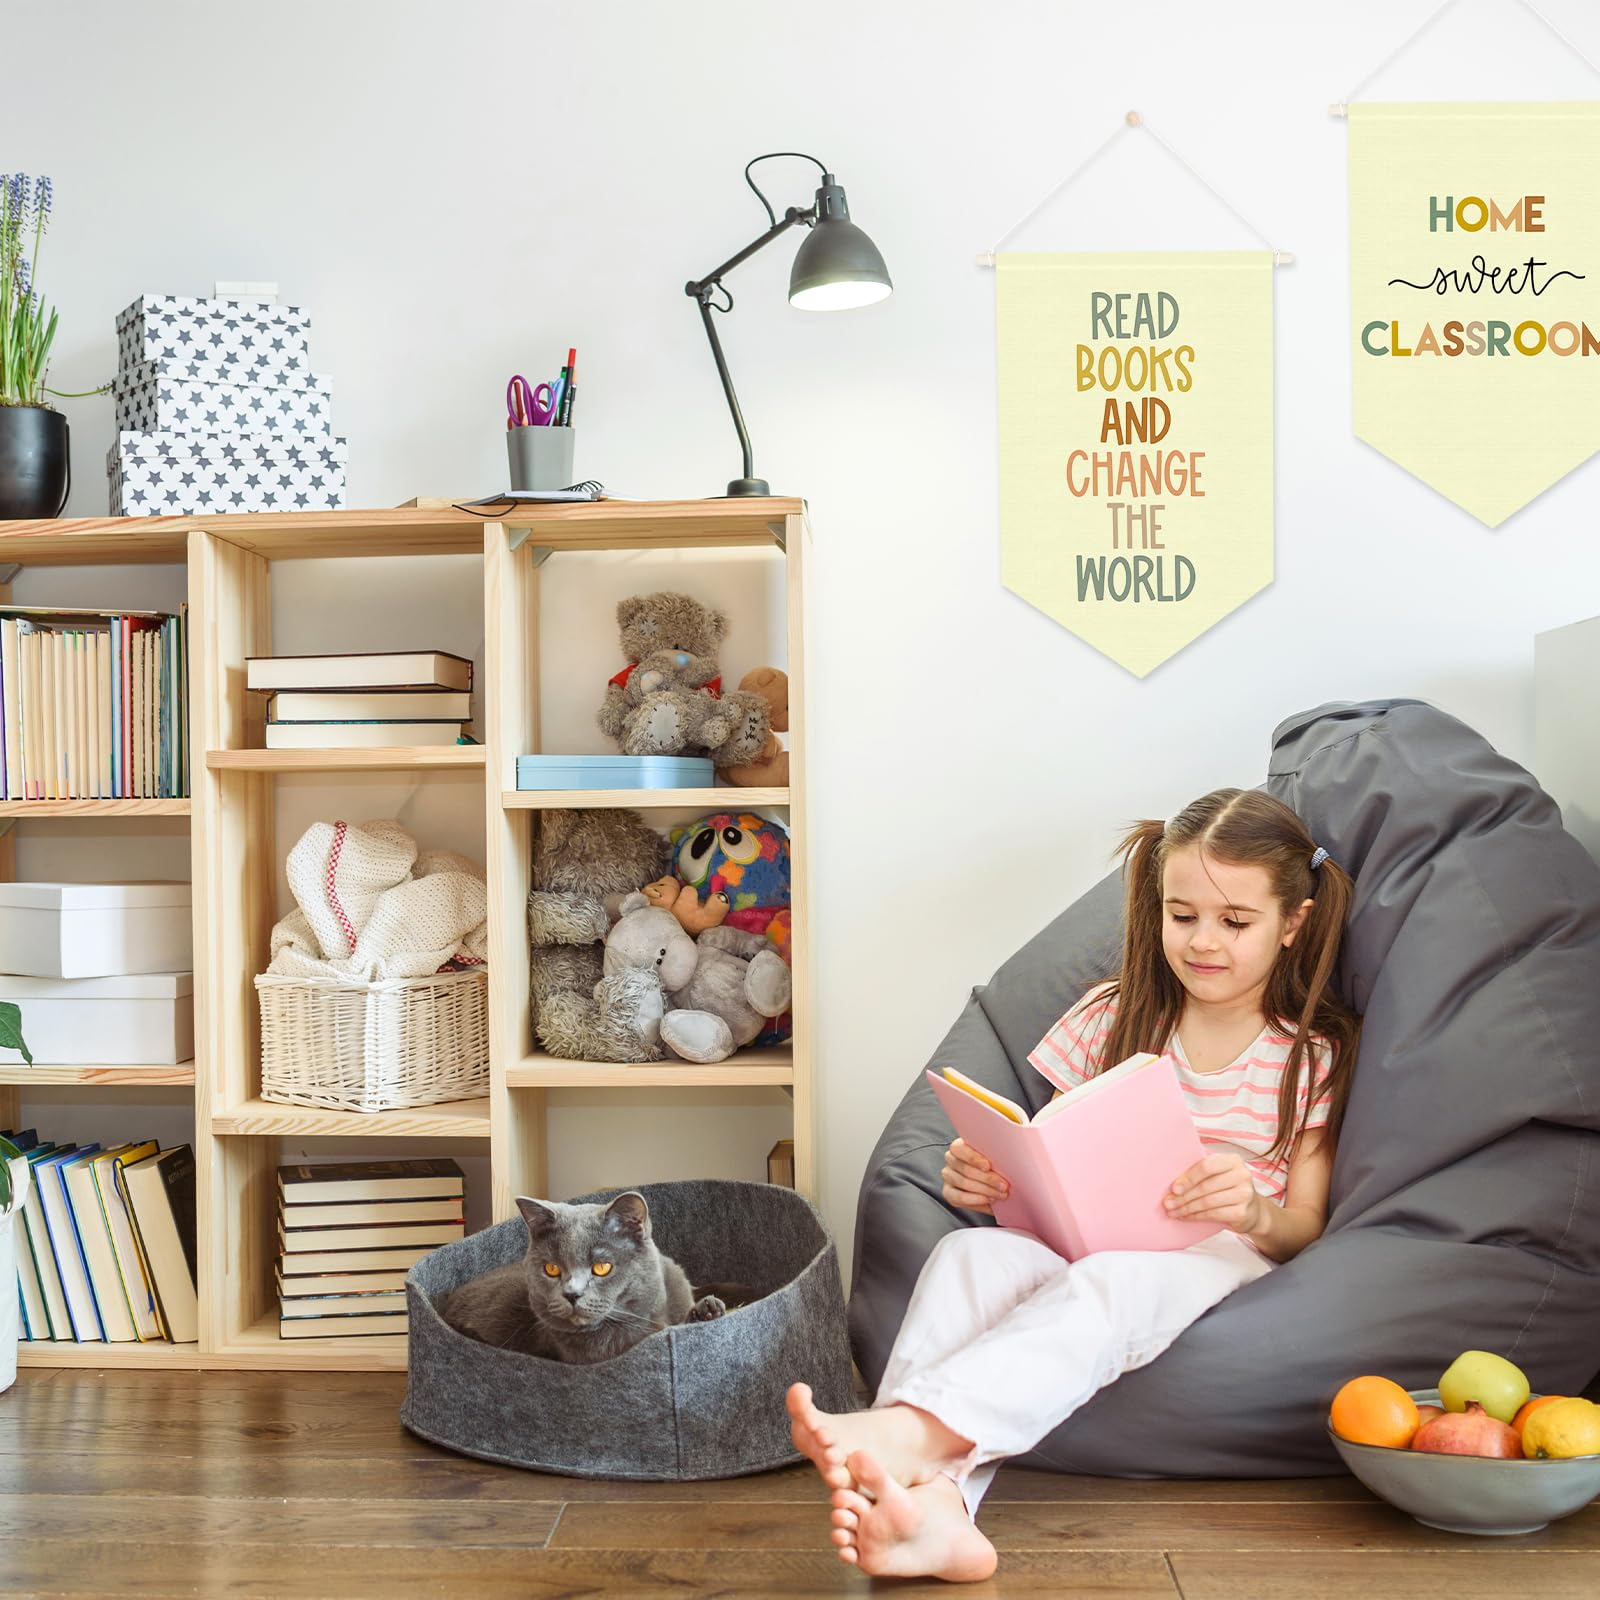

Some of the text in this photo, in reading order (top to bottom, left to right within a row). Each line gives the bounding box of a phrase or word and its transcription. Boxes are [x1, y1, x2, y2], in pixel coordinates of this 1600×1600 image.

[1429, 195, 1546, 233] HOME
[1388, 255, 1586, 296] sweet
[1091, 291, 1179, 340] READ
[1075, 344, 1195, 393] BOOKS
[1100, 396, 1172, 446] AND
[1066, 449, 1206, 498] CHANGE
[1106, 502, 1166, 550] THE
[1075, 554, 1196, 603] WORLD
